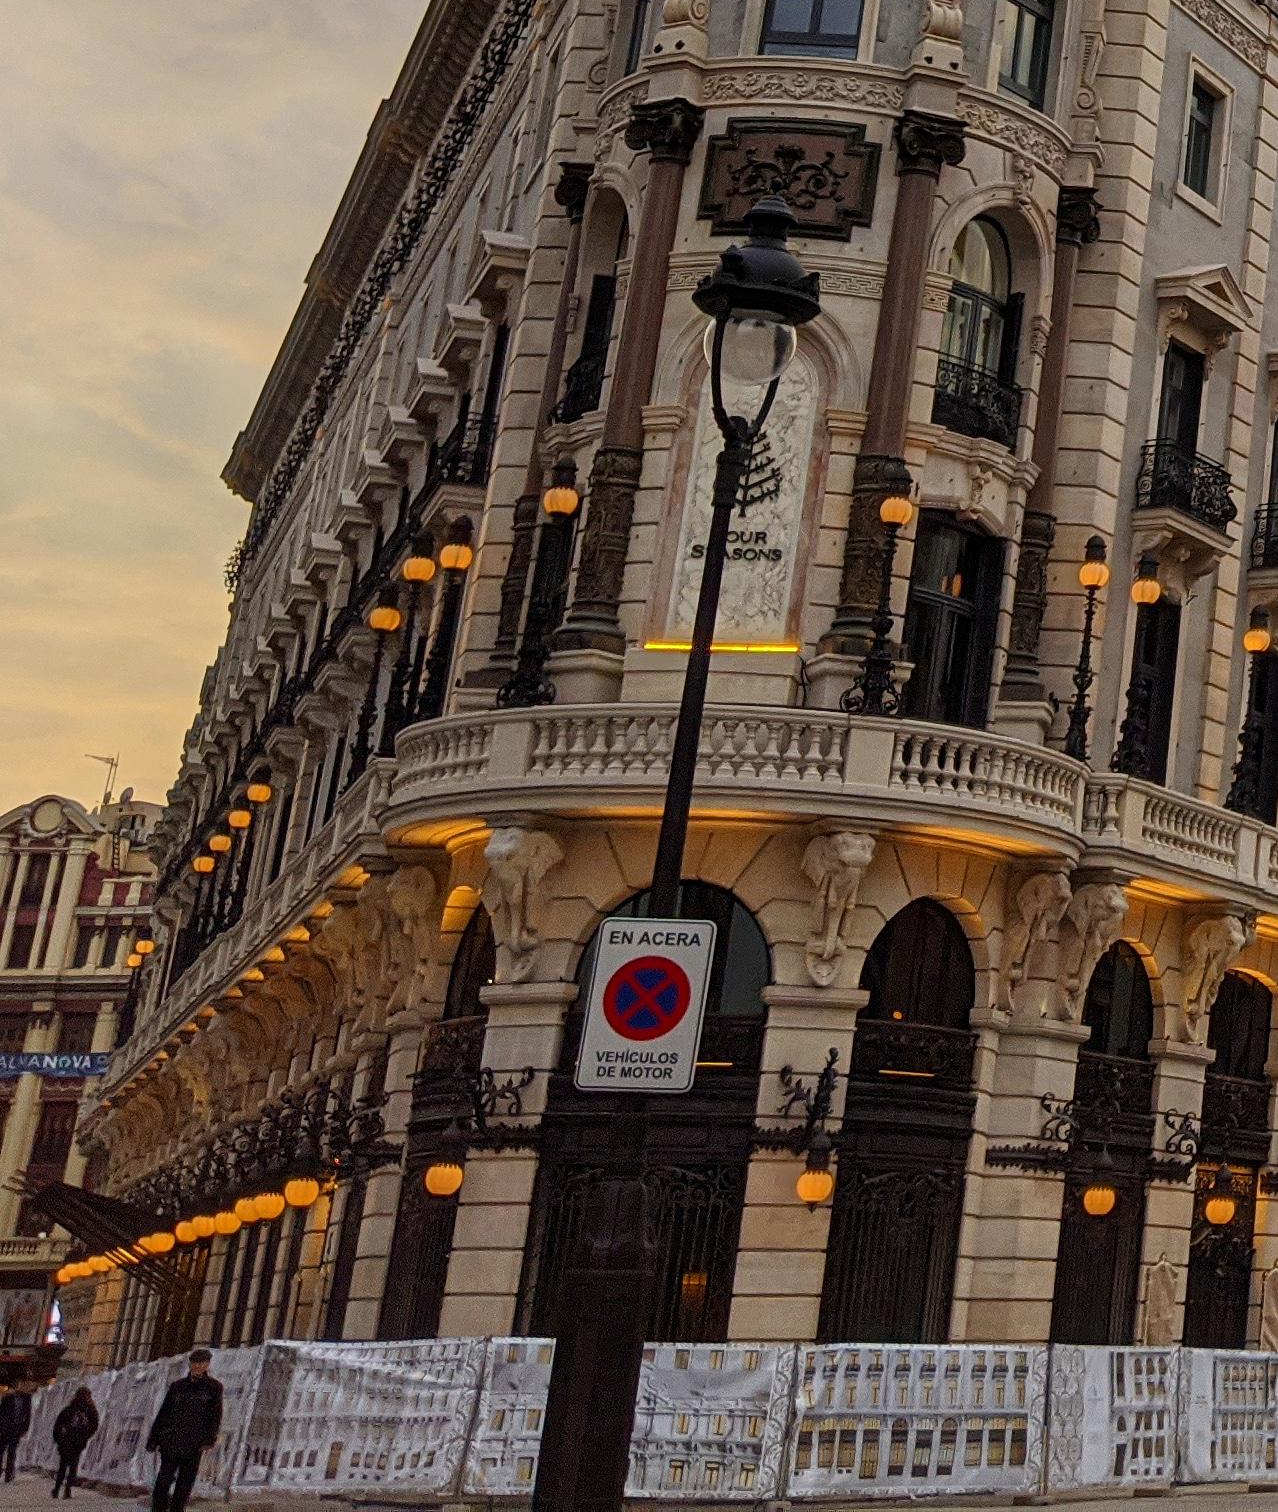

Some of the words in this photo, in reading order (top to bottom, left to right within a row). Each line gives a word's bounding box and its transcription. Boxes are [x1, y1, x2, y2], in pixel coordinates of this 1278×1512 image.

[726, 530, 768, 545] OUR
[609, 930, 634, 945] EN
[638, 931, 701, 947] ACERA
[596, 1049, 679, 1064] VEHÍCULOS
[596, 1065, 617, 1078] DE
[620, 1066, 674, 1080] MOTOR
